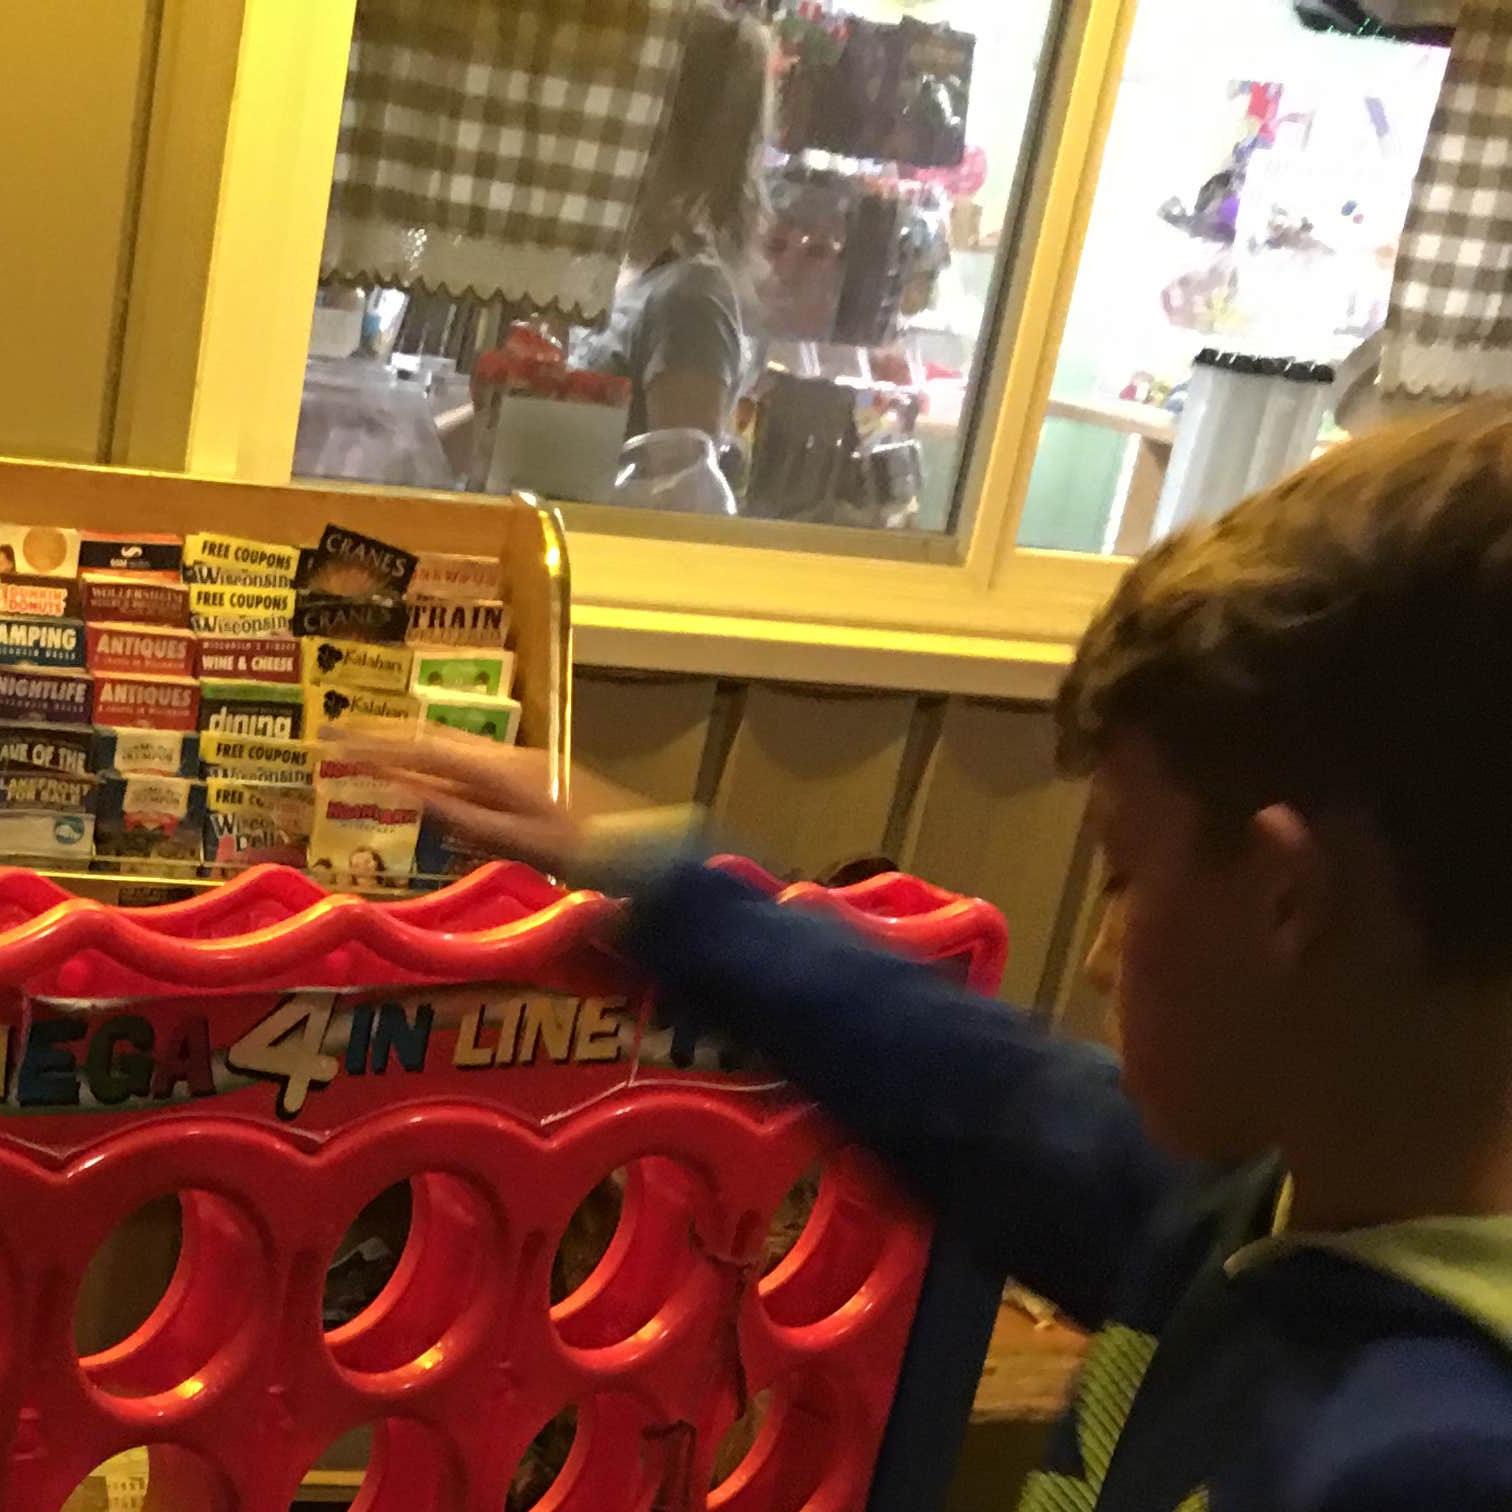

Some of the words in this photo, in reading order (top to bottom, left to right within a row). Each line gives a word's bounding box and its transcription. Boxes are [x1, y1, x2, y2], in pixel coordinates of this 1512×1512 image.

[202, 540, 230, 558] FREE
[235, 546, 291, 570] COUPONS
[326, 533, 408, 576] CRANES
[196, 590, 225, 607] FREE
[230, 592, 288, 610] COUPONS
[408, 605, 504, 629] TRAIN
[97, 633, 188, 659] ANTIQUES
[202, 655, 235, 671] WINE
[238, 656, 247, 671] &
[251, 656, 294, 673] CHEESE
[100, 683, 193, 707] ANTIQUES
[32, 743, 56, 767] OF
[59, 747, 87, 774] THE
[216, 743, 244, 759] FREE
[248, 748, 309, 765] COUPONS
[0, 776, 90, 797] LAKEFRONT
[216, 789, 244, 804] FREE
[225, 990, 340, 1120] 4
[344, 1001, 434, 1076] IN
[453, 995, 628, 1068] LINE
